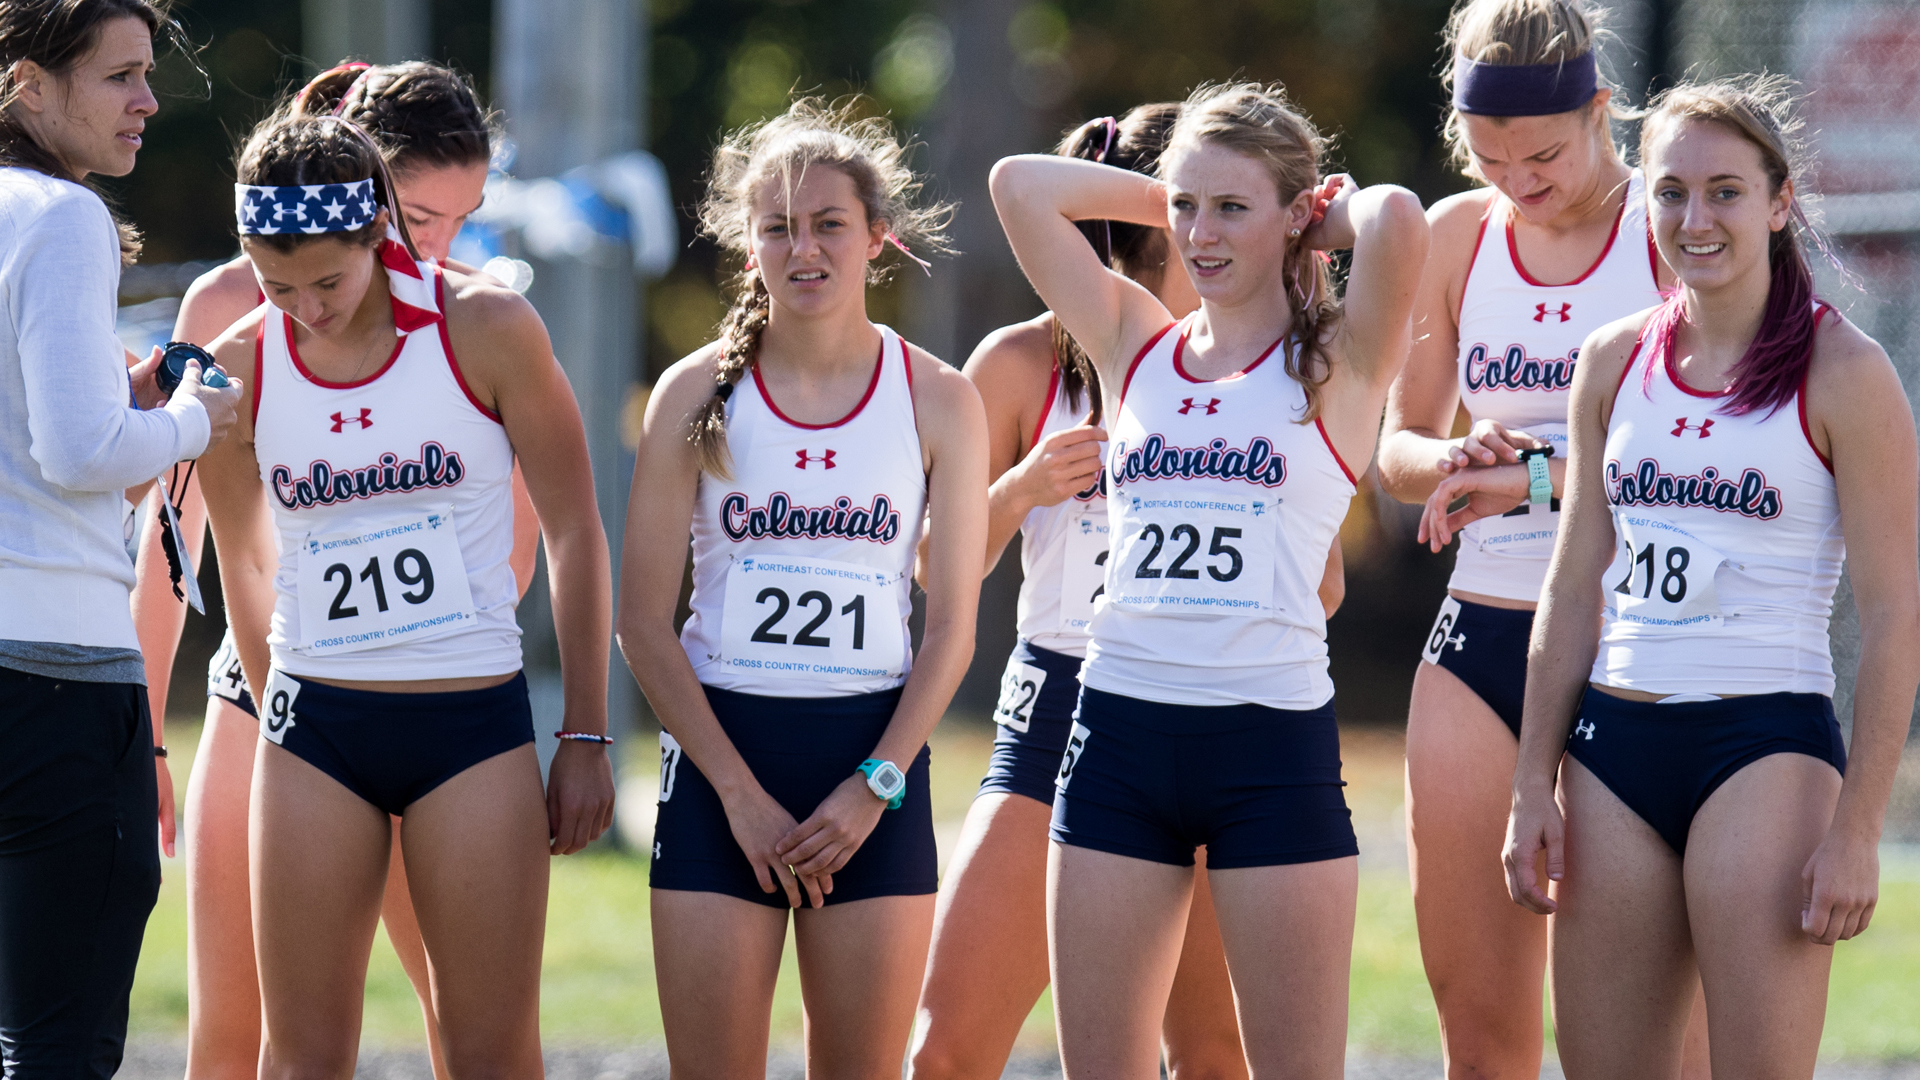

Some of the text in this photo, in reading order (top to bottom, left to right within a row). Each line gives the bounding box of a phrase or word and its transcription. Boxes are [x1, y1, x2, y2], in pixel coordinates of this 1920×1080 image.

[270, 441, 465, 510] Colonials
[1110, 433, 1287, 488] Colonials
[1143, 500, 1247, 512] NORTHEAST CONFERENCE
[1606, 458, 1783, 521] Colonials
[322, 522, 424, 550] NORTHEAST CONFERENCE
[719, 491, 901, 545] Colonials
[1488, 530, 1553, 545] CROSS COUNTRY
[757, 563, 872, 582] NORTHEAST CONFERENCE
[1134, 523, 1244, 582] 225
[323, 548, 435, 621] 219
[1117, 596, 1260, 609] CROSS COUNTRY CHAMPIONSHIPS
[314, 611, 463, 649] CROSS COUNTRY CHAMPIONSHIPS
[750, 587, 865, 650] 221
[1430, 613, 1452, 654] 6
[1642, 614, 1711, 626] CHAMPIONSHIPS
[732, 658, 888, 676] CROSS COUNTRY CHAMPIONSHIPS
[662, 746, 676, 793] 1
